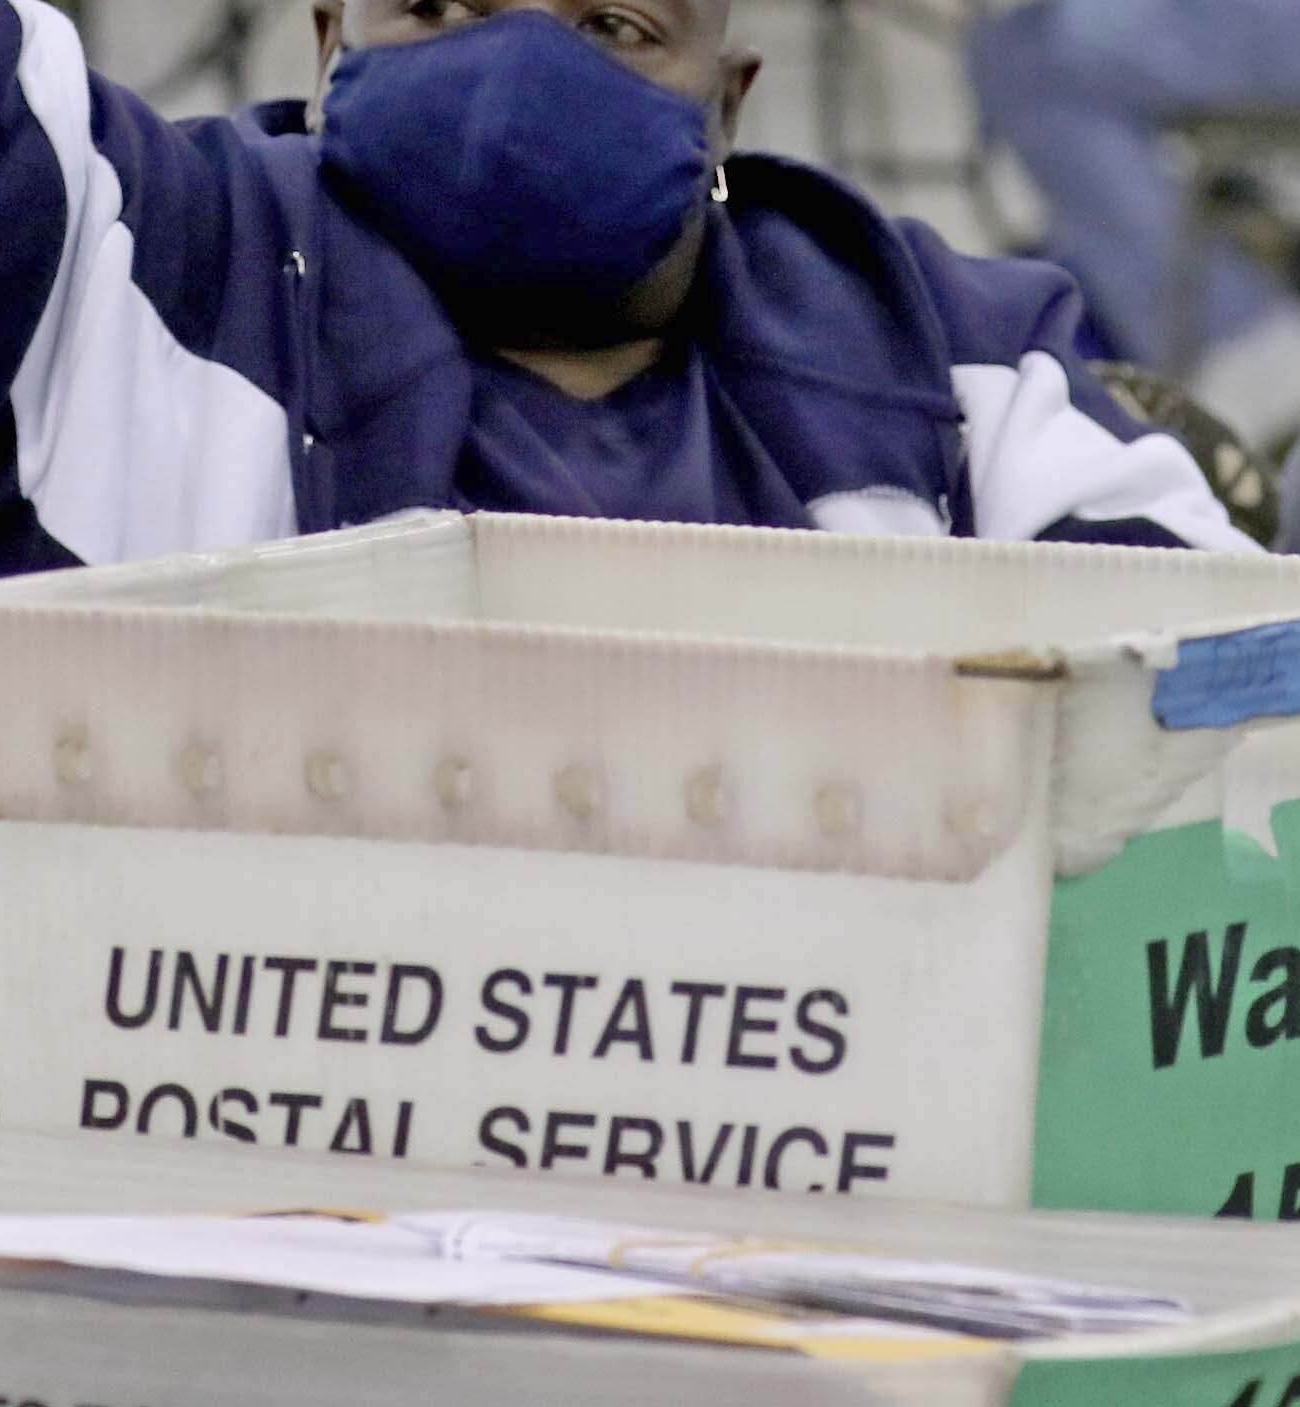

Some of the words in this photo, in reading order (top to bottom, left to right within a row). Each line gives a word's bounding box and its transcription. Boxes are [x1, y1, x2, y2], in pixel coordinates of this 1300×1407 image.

[103, 945, 446, 1047] UNITED
[473, 966, 851, 1076] STATES
[477, 1104, 896, 1194] SERVICE
